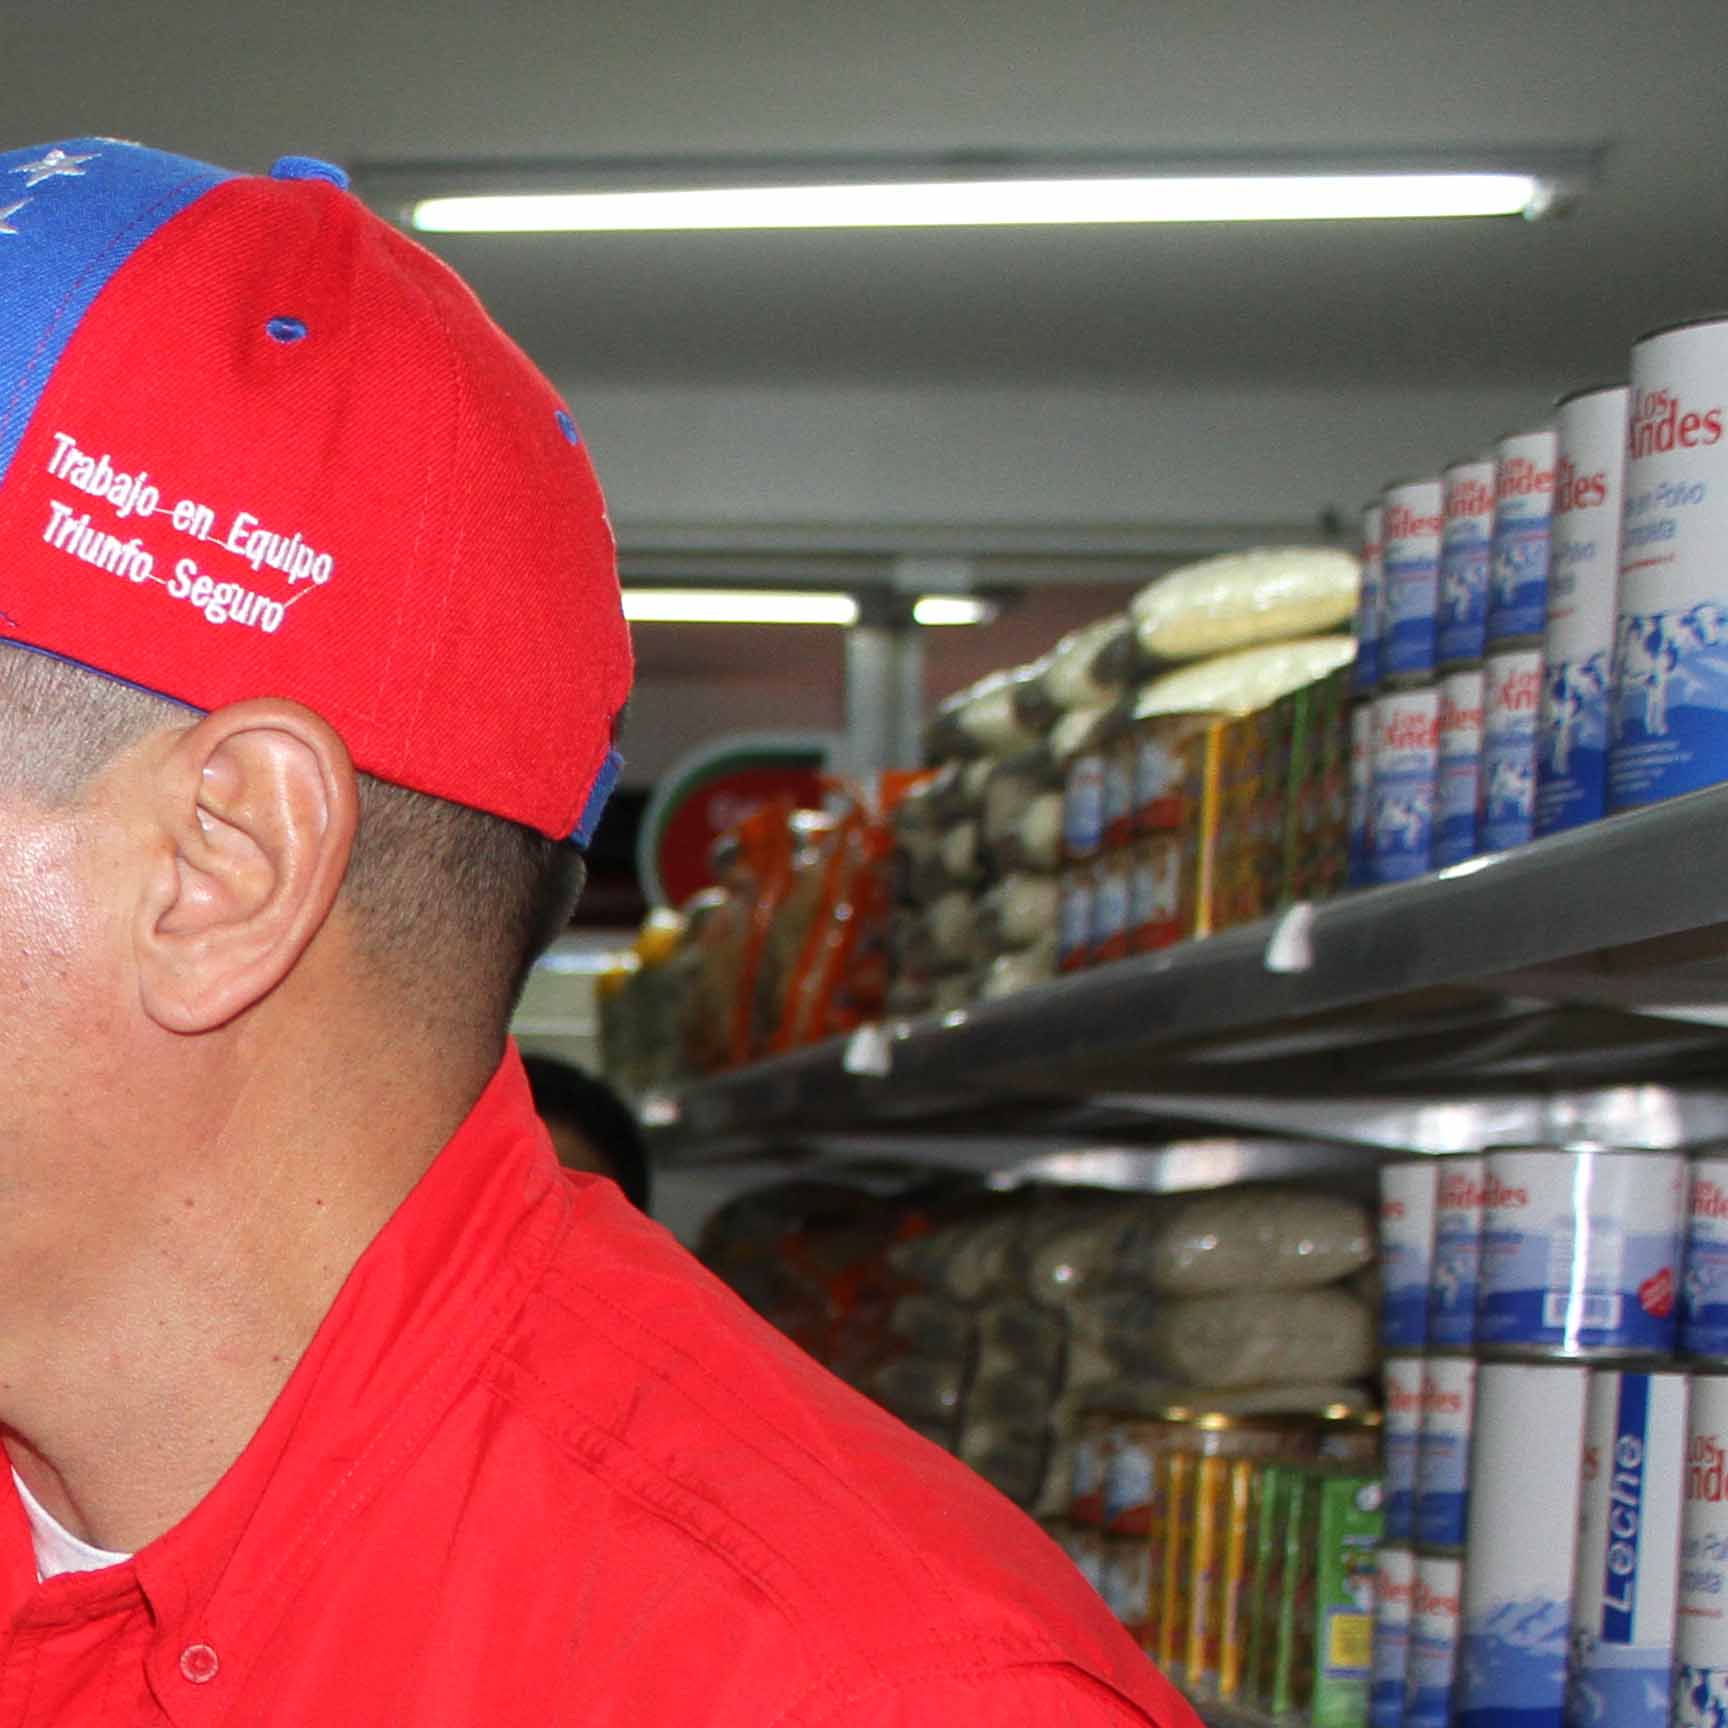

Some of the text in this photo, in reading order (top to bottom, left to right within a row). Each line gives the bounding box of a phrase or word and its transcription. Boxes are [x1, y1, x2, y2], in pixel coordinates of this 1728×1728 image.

[42, 499, 285, 633] Triunfo Seguro
[47, 431, 335, 586] Trabajo en Equipo
[1602, 1433, 1643, 1614] Leche
